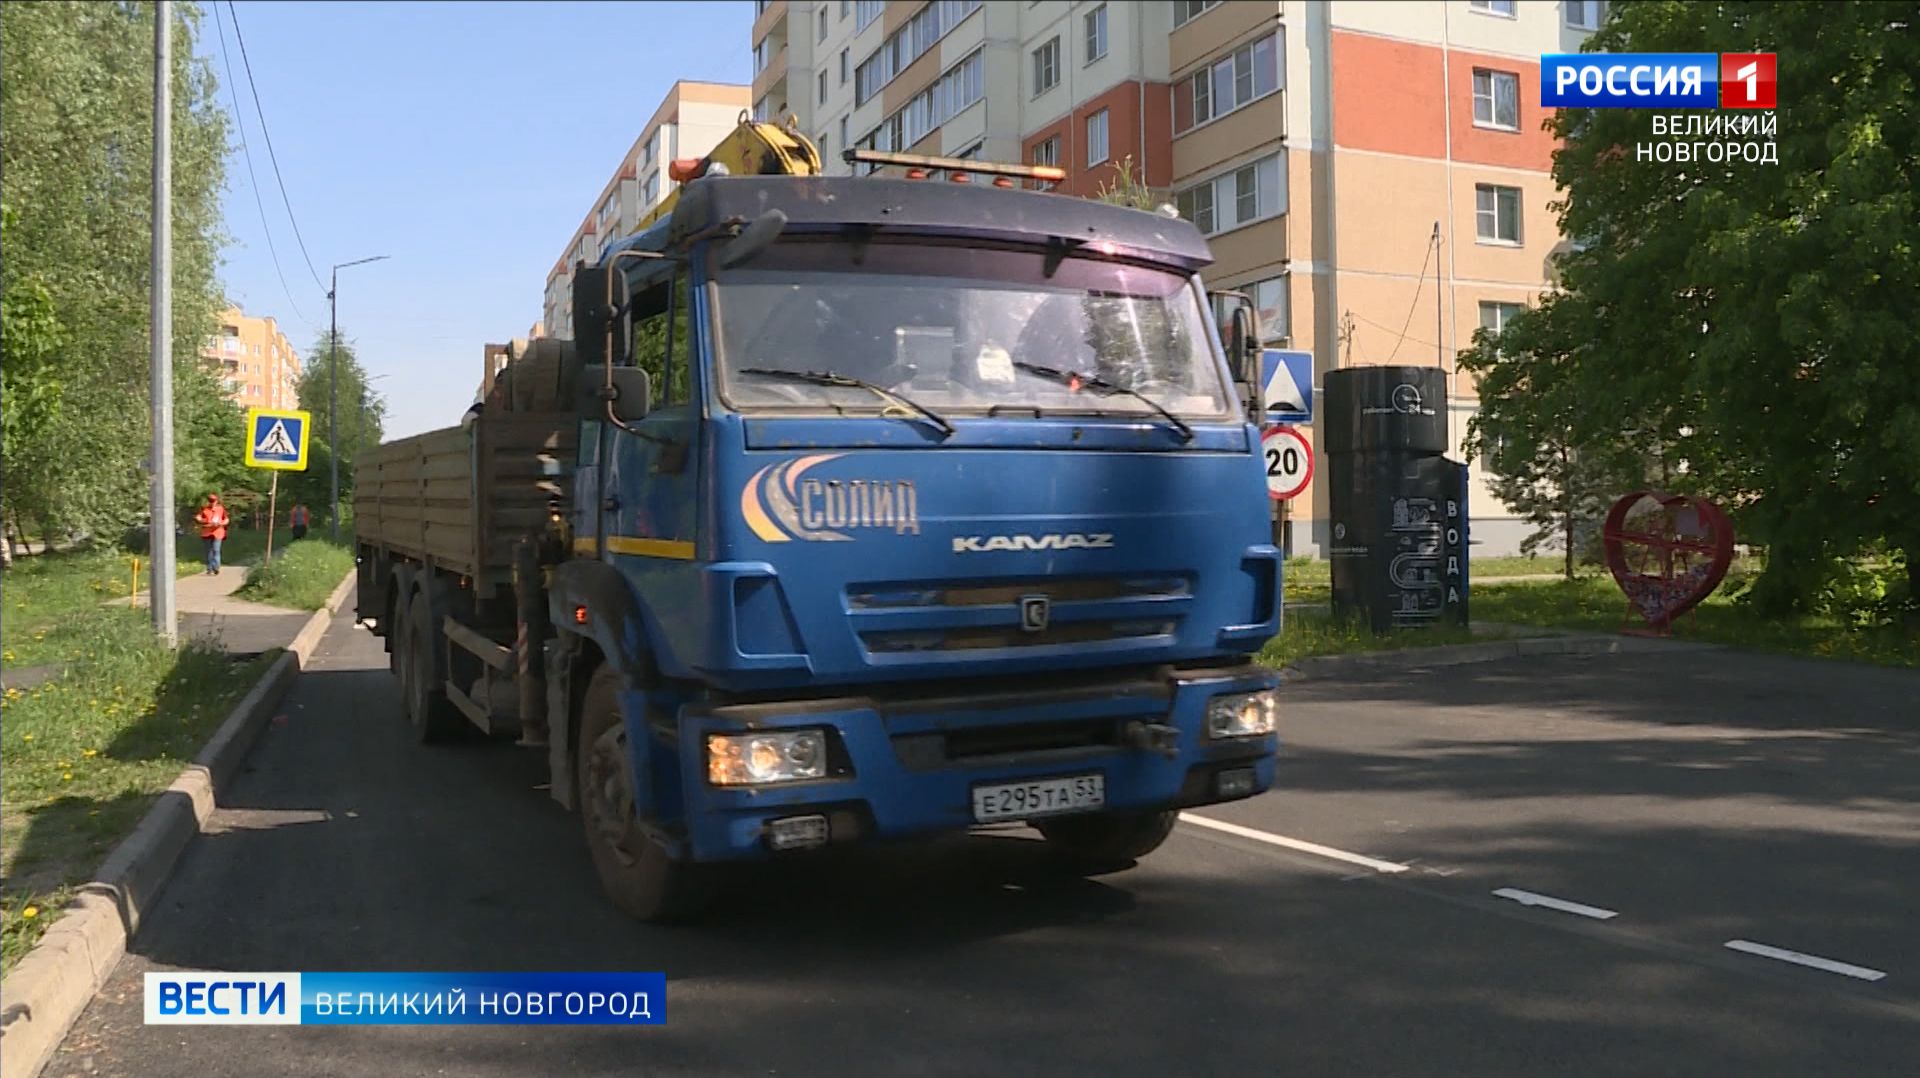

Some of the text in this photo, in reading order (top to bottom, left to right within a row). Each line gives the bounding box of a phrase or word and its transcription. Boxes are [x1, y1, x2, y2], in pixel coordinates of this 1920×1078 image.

[1266, 448, 1298, 476] 20
[802, 478, 920, 535] СОЛИД
[952, 534, 1114, 552] KAMAZ
